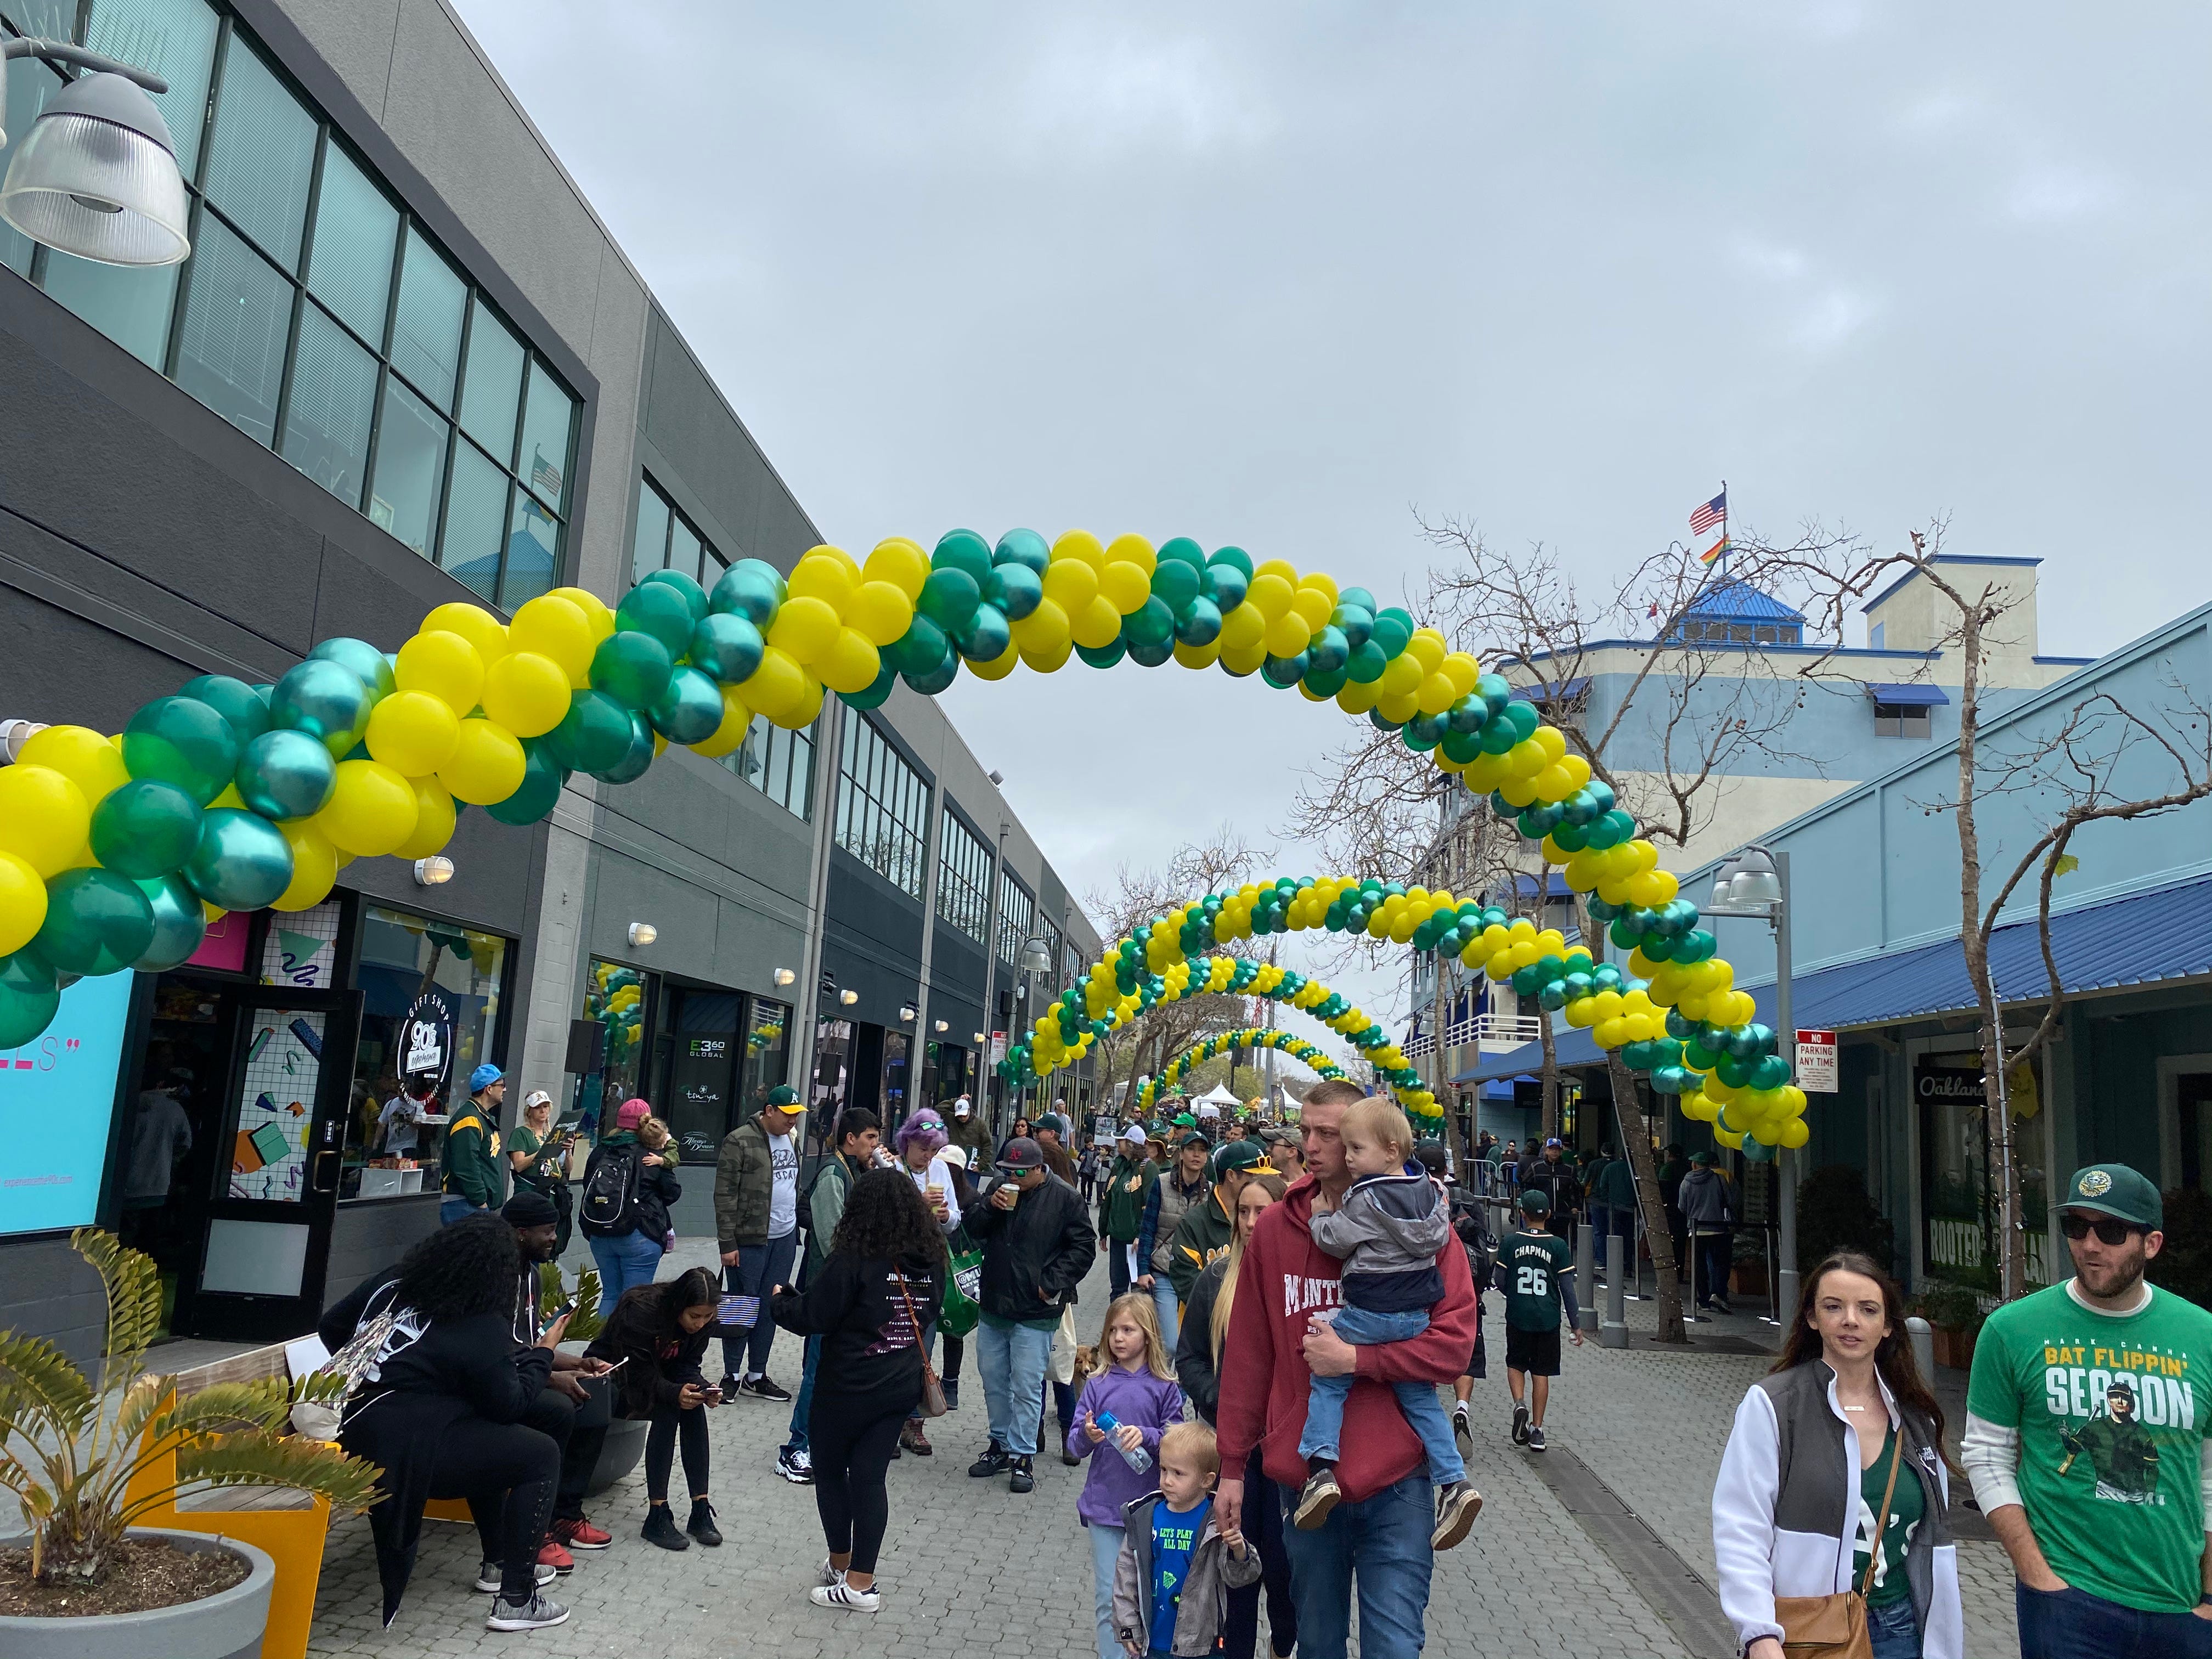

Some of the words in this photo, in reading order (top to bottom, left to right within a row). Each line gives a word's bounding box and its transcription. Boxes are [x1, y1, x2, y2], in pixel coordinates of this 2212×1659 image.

[409, 994, 427, 1017] GIFT
[432, 994, 449, 1020] SHOP
[410, 1020, 437, 1051] 90's
[1811, 1034, 1821, 1043] NO
[691, 1040, 725, 1051] E360
[1801, 1046, 1832, 1056] PARKING
[1799, 1057, 1814, 1065] ANY
[1816, 1058, 1834, 1066] TIME
[427, 1084, 439, 1103] STREET
[1010, 1148, 1022, 1160] A's
[1930, 1219, 1982, 1267] ROOTED
[1515, 1245, 1551, 1264] CHAPMAN
[961, 1279, 979, 1289] NETW
[1517, 1266, 1547, 1296] 26
[2121, 1341, 2187, 1359] CANHA
[2045, 1347, 2085, 1365] BAT
[2095, 1348, 2188, 1377] FLIPPIN'
[1160, 1528, 1174, 1538] LET'S
[1176, 1529, 1193, 1539] PLAY
[1164, 1538, 1175, 1549] ALL
[1178, 1540, 1191, 1550] DAY
